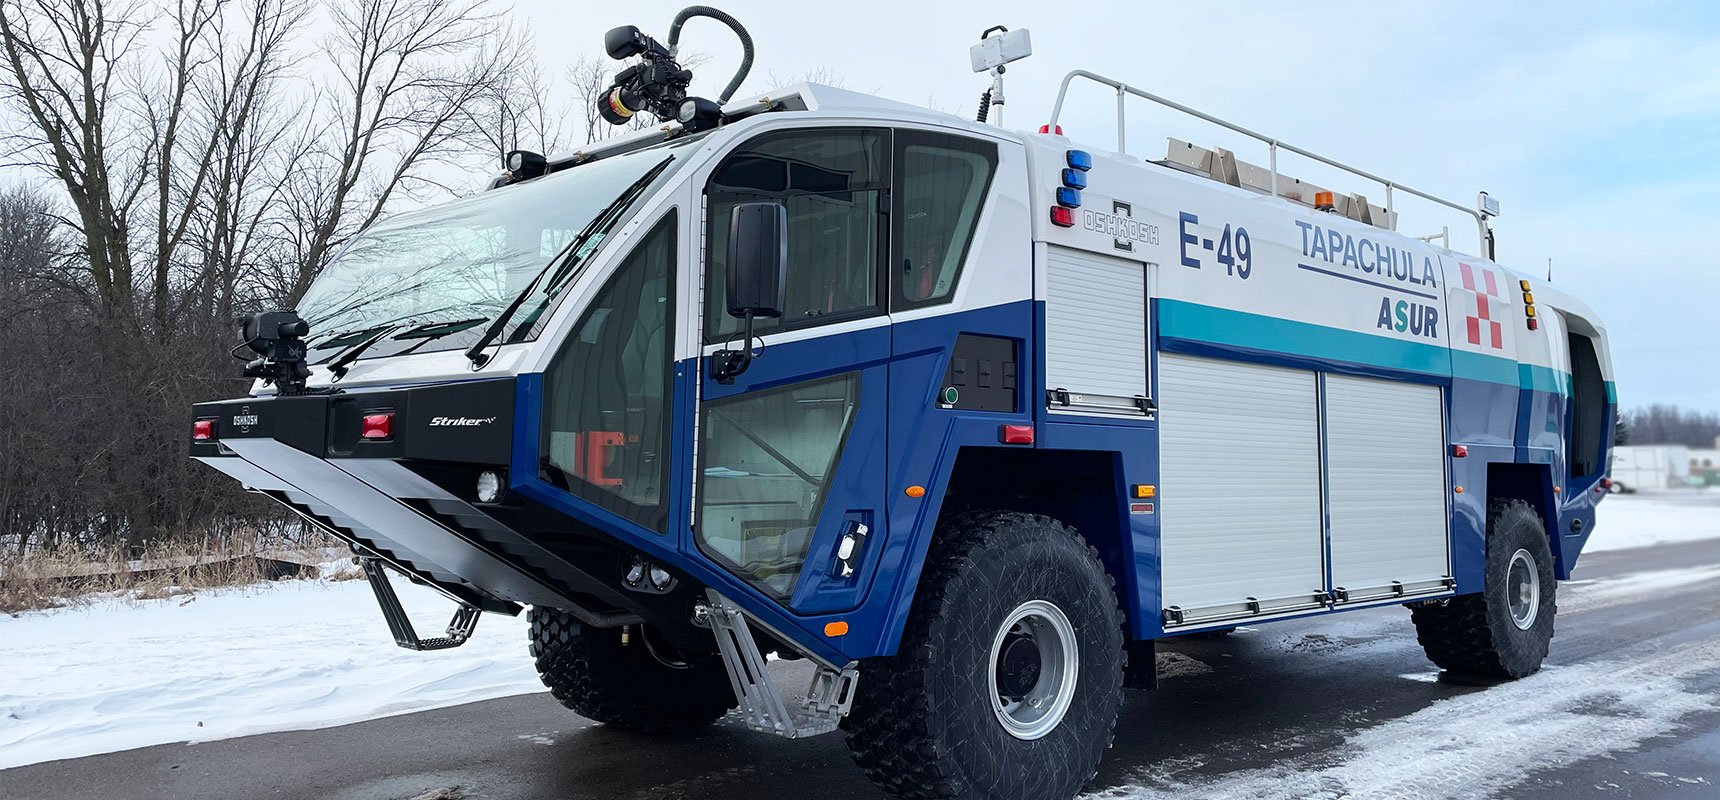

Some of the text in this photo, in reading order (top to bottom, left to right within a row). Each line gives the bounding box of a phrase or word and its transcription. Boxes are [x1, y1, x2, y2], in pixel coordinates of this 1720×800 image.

[1083, 209, 1160, 246] OSHKOSH
[1179, 211, 1252, 280] E-49
[1295, 219, 1437, 289] TAPACHULA
[1376, 296, 1438, 339] ASUR
[233, 415, 258, 426] OSHKOSH
[429, 417, 481, 426] Striker
